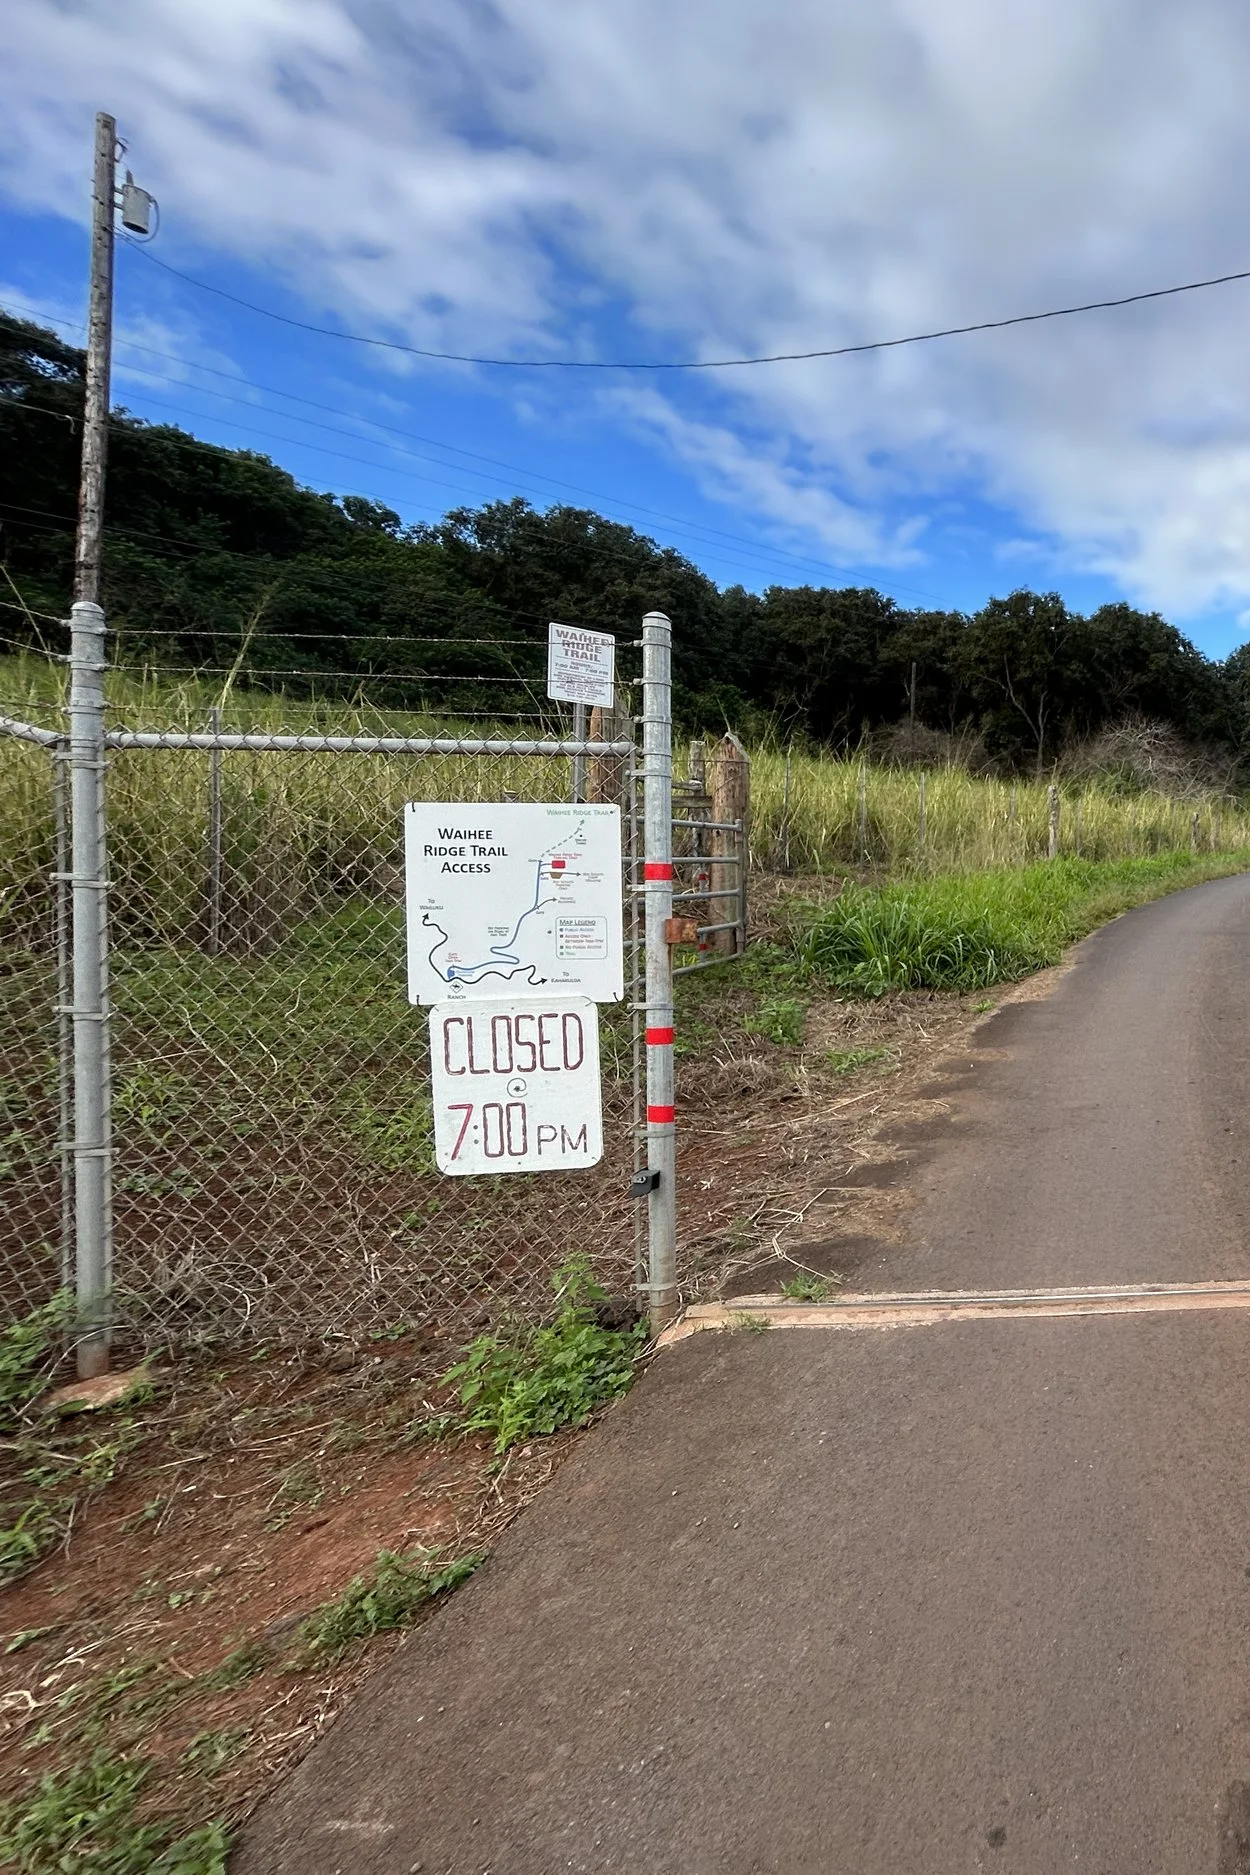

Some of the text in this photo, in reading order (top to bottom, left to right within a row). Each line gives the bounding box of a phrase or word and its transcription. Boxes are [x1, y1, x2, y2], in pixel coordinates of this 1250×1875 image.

[562, 639, 602, 654] RIDGE
[563, 648, 601, 662] TRAIL
[438, 828, 493, 840] WAIHEE
[424, 845, 509, 856] RIDGE TRAIL
[441, 862, 491, 873] ACCESS
[443, 1013, 584, 1076] CLOSED
[448, 1102, 588, 1161] 7:00 PM
